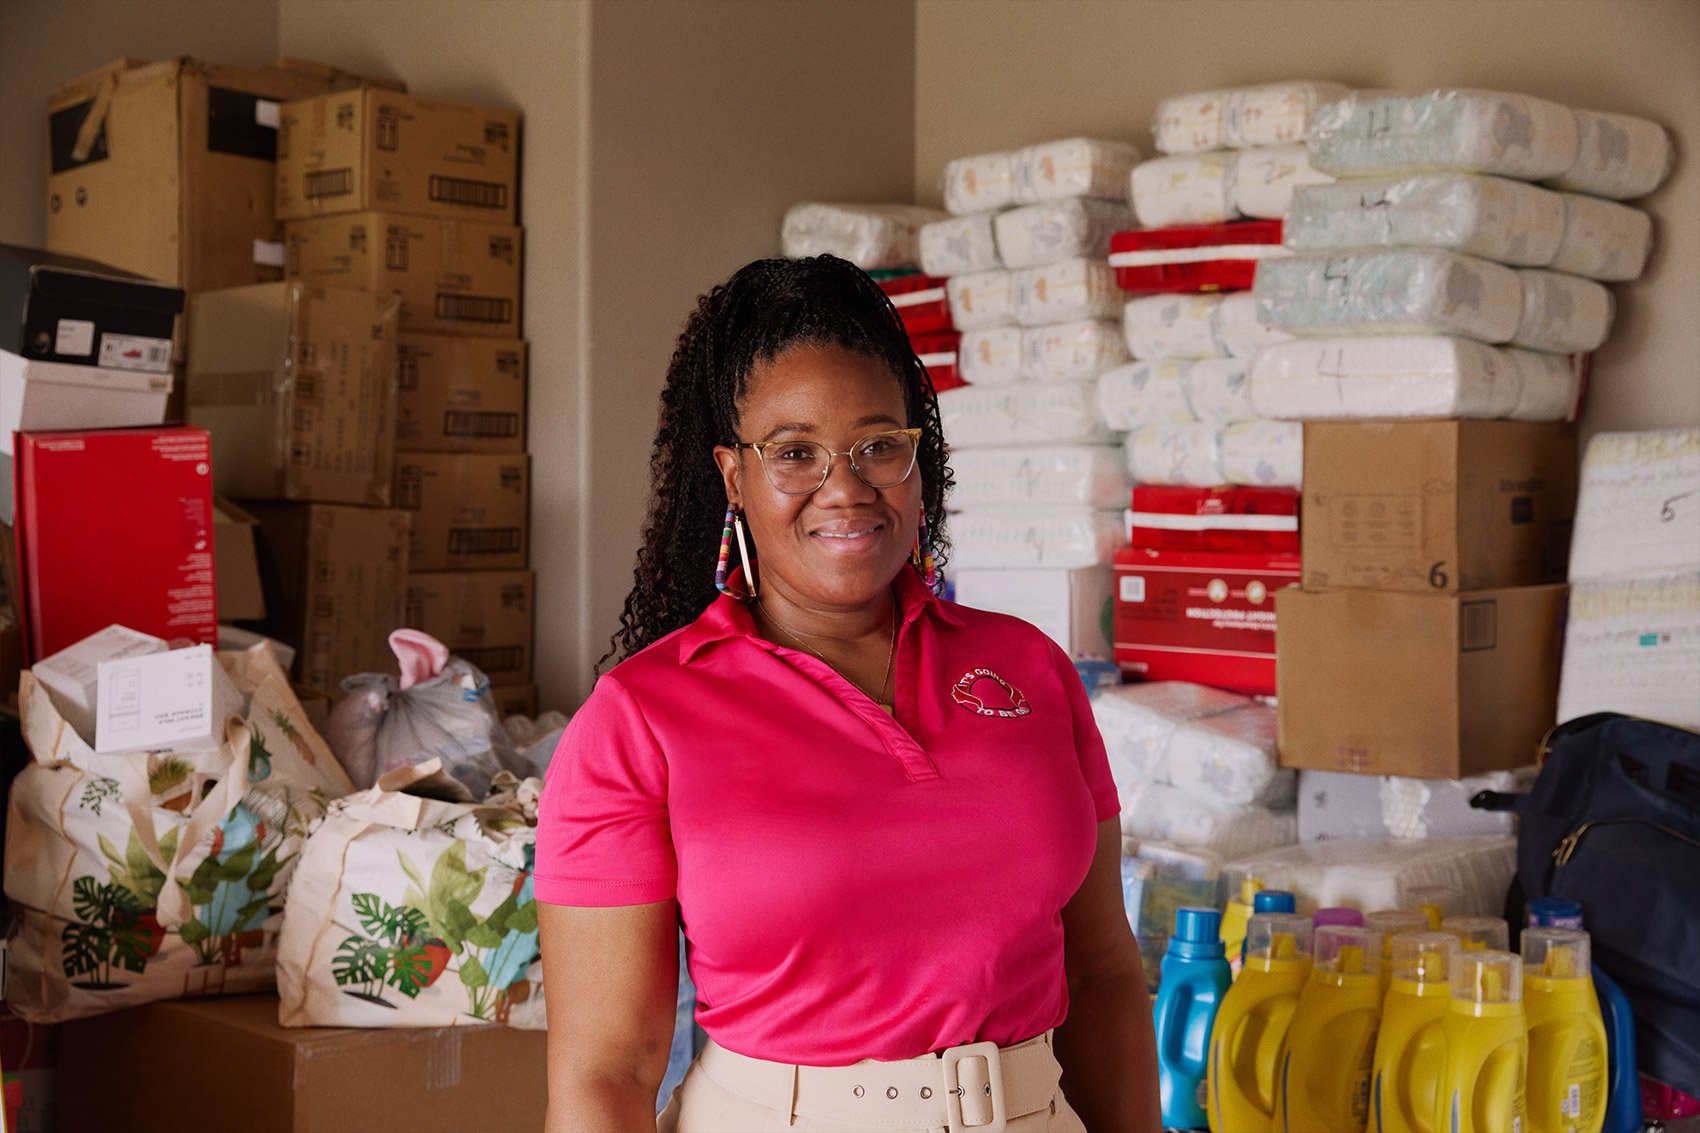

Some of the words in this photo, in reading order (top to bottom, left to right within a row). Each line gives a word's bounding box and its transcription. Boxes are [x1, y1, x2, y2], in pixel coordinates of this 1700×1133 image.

[1317, 348, 1348, 406] 4
[1428, 560, 1449, 590] 6
[974, 668, 1006, 686] GOING
[977, 707, 994, 716] TO
